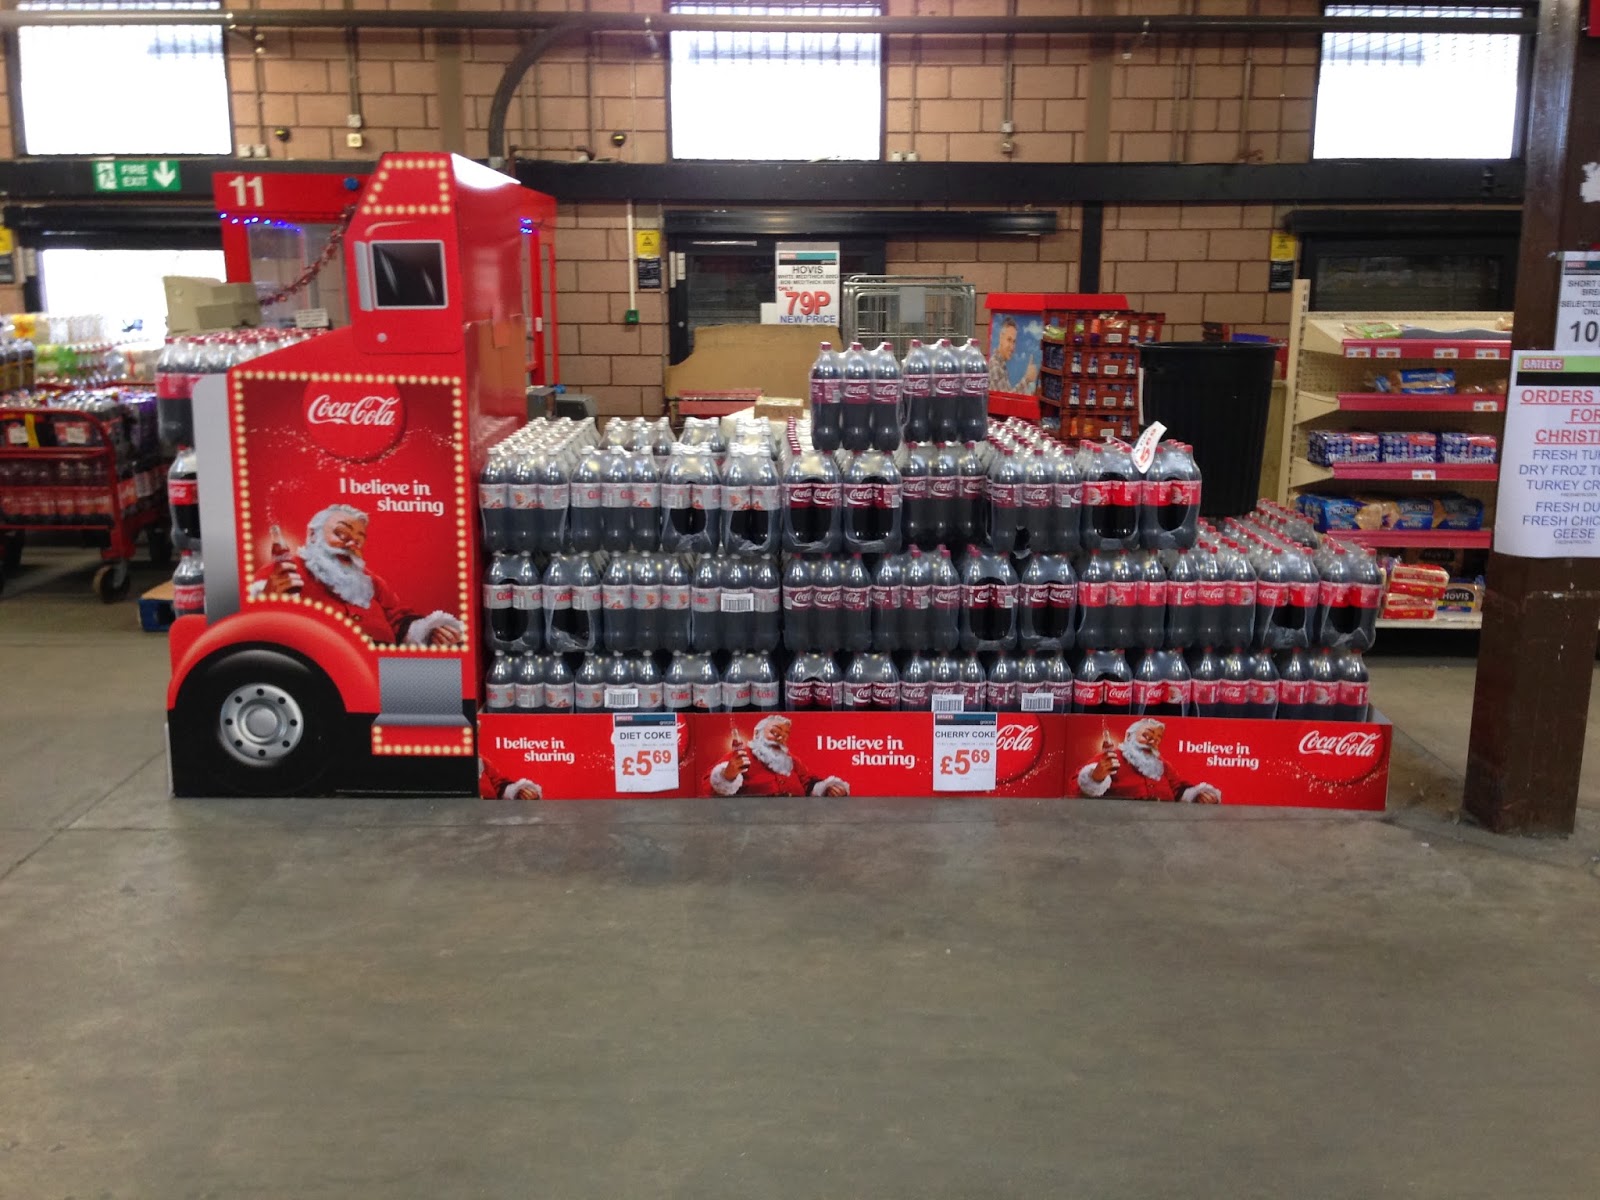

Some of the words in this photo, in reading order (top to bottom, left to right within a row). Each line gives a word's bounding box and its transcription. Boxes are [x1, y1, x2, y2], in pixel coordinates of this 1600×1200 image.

[121, 164, 148, 174] FIRE
[122, 176, 148, 187] EXIT
[228, 176, 264, 206] 11
[780, 315, 803, 324] NEW
[806, 315, 836, 324] PRICE
[1521, 390, 1594, 403] ORDERS
[1536, 430, 1600, 442] CHRIST
[1533, 450, 1577, 460] FRESH
[1519, 465, 1548, 475] DRY
[1552, 465, 1587, 476] FROZ
[339, 478, 346, 494] I
[350, 479, 409, 496] believe
[414, 480, 431, 496] in
[1526, 480, 1580, 490] TURKEY
[377, 496, 444, 516] sharing
[1536, 502, 1579, 512] FRESH
[1522, 515, 1567, 526] FRESH
[1554, 528, 1595, 539] GEESE
[620, 732, 642, 740] DIET
[644, 732, 672, 740] COKE
[995, 724, 1038, 751] Cola
[496, 737, 500, 749] I
[504, 737, 548, 750] believe
[551, 737, 565, 749] in
[817, 736, 822, 750] I
[827, 736, 883, 750] believe
[887, 735, 904, 750] in
[1179, 740, 1183, 752] I
[1187, 741, 1232, 754] believe
[1236, 742, 1250, 754] in
[524, 750, 575, 764] sharing
[852, 751, 916, 769] sharing
[1206, 755, 1259, 770] sharing
